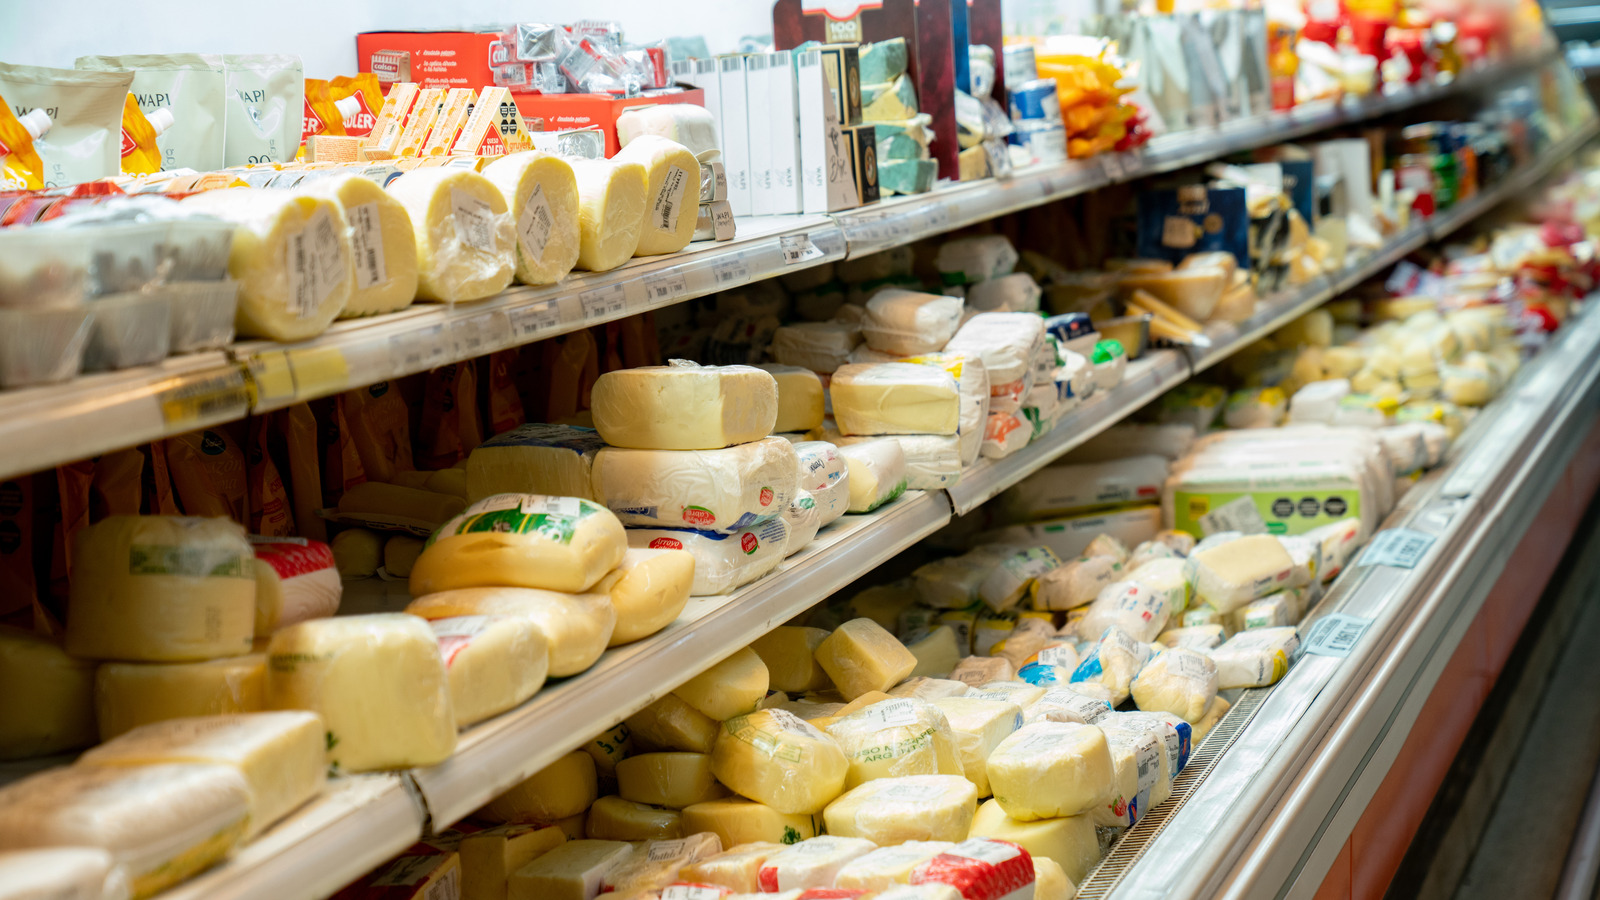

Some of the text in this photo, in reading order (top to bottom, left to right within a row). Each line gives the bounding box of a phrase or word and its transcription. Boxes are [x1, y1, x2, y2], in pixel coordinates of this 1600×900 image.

[829, 21, 857, 33] 100
[133, 94, 171, 106] WAPI
[16, 106, 58, 119] WPI
[482, 144, 504, 156] ADLER
[654, 538, 680, 548] Arroyo
